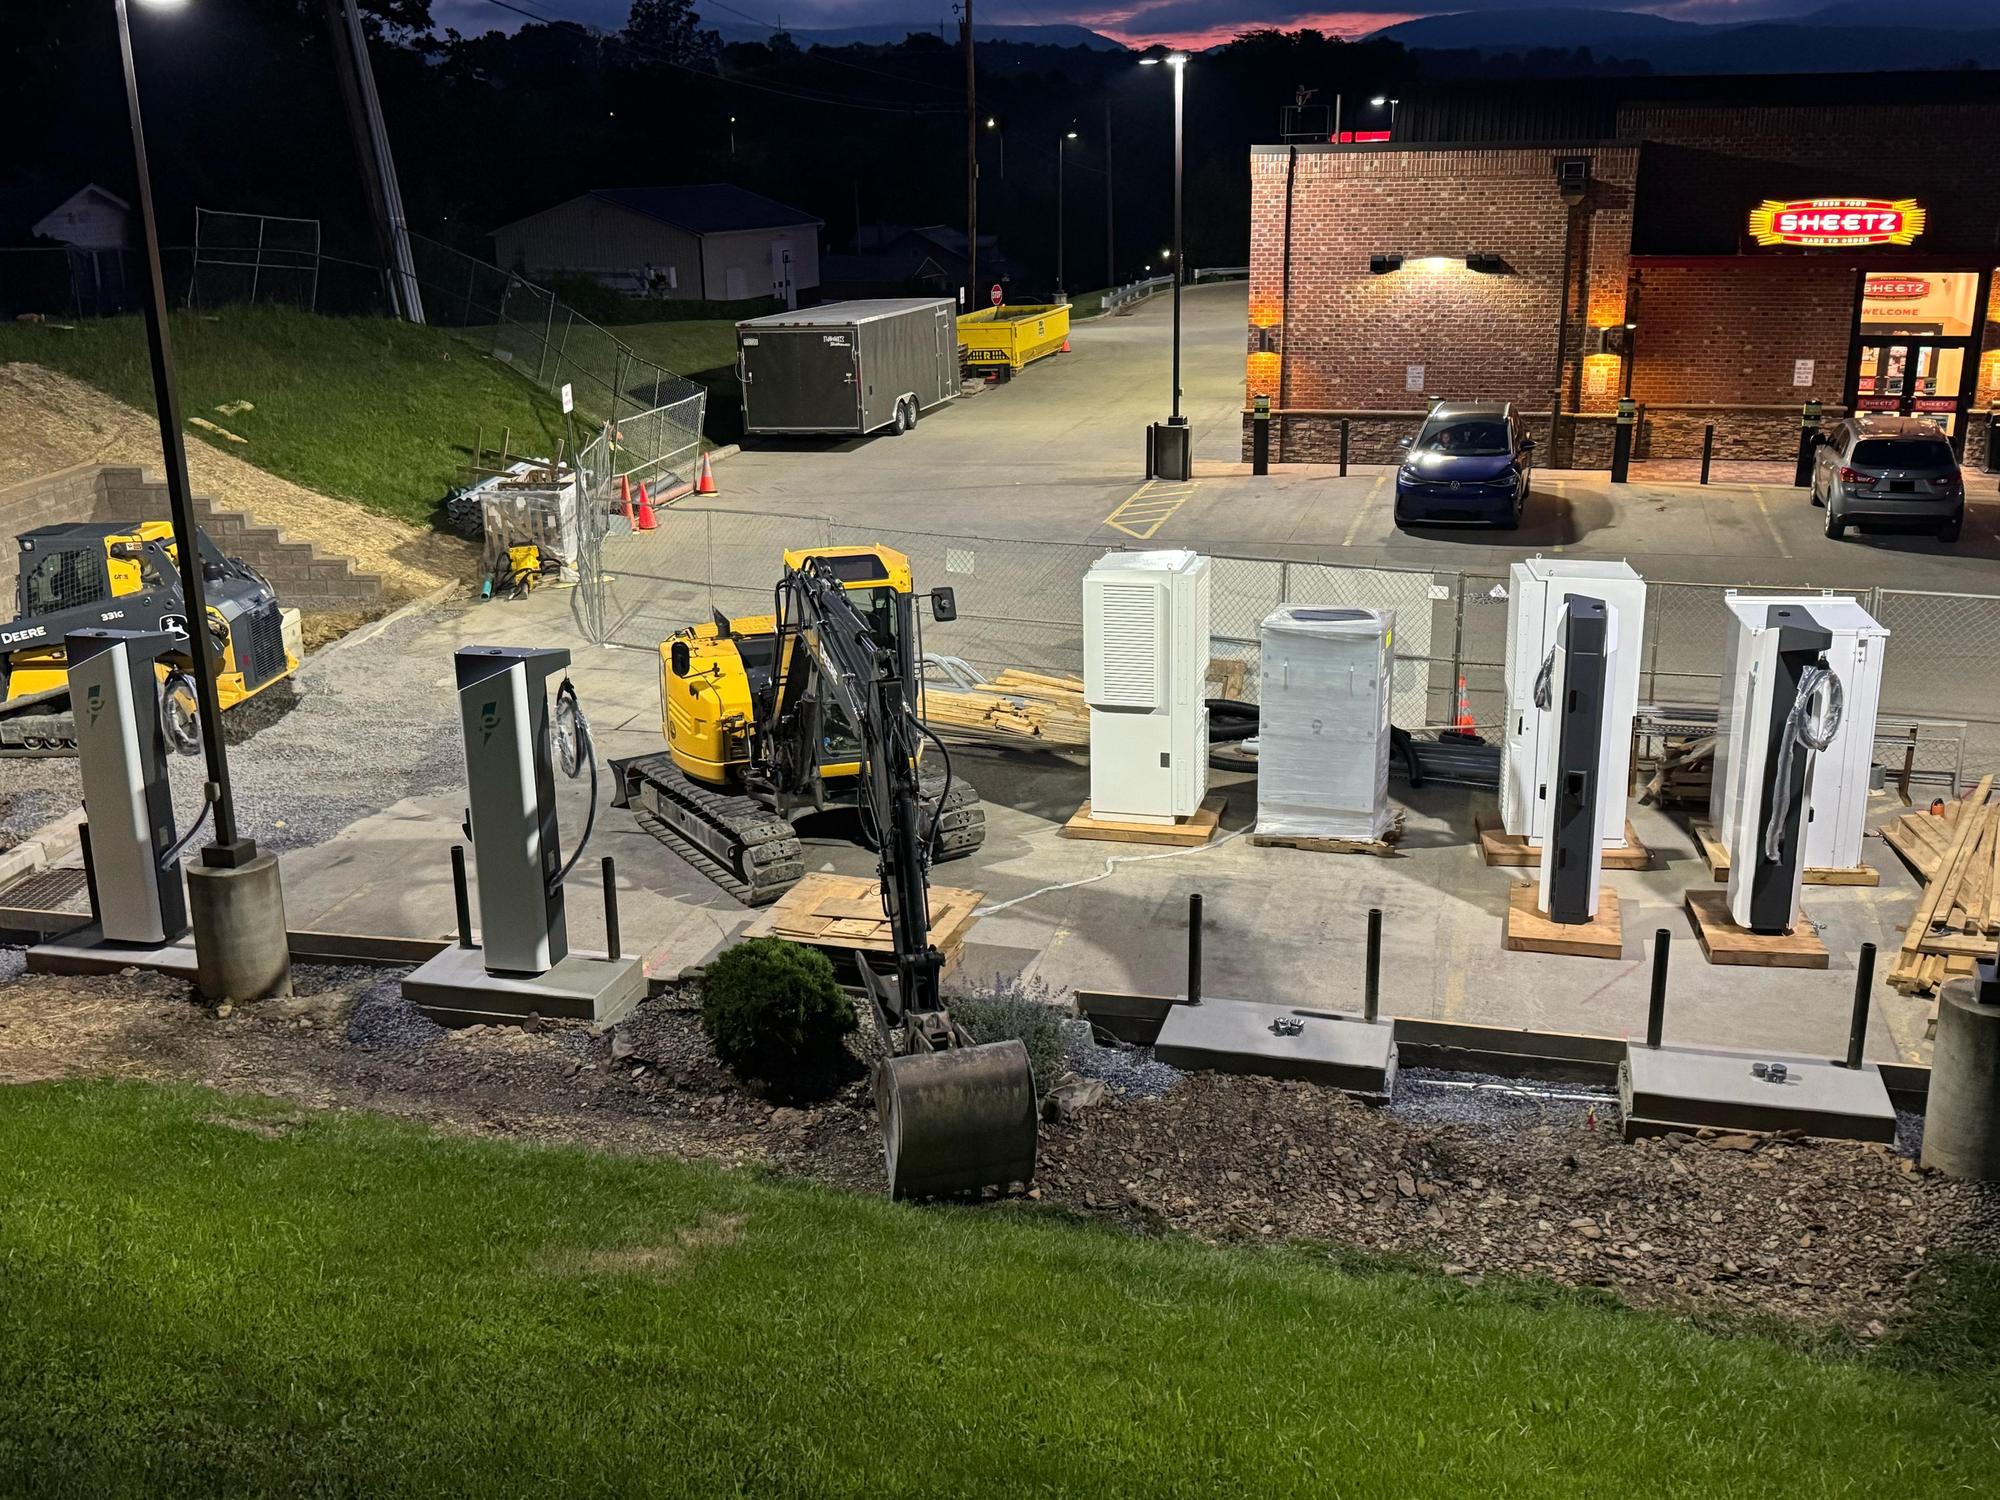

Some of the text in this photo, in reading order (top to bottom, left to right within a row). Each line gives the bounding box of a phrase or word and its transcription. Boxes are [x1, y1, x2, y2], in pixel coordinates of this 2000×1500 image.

[1780, 213, 1897, 231] SHEETZ
[1864, 284, 1924, 293] SHEETZ
[1863, 308, 1919, 316] WELCOME
[100, 610, 124, 622] 331G
[1, 626, 47, 645] DEERE
